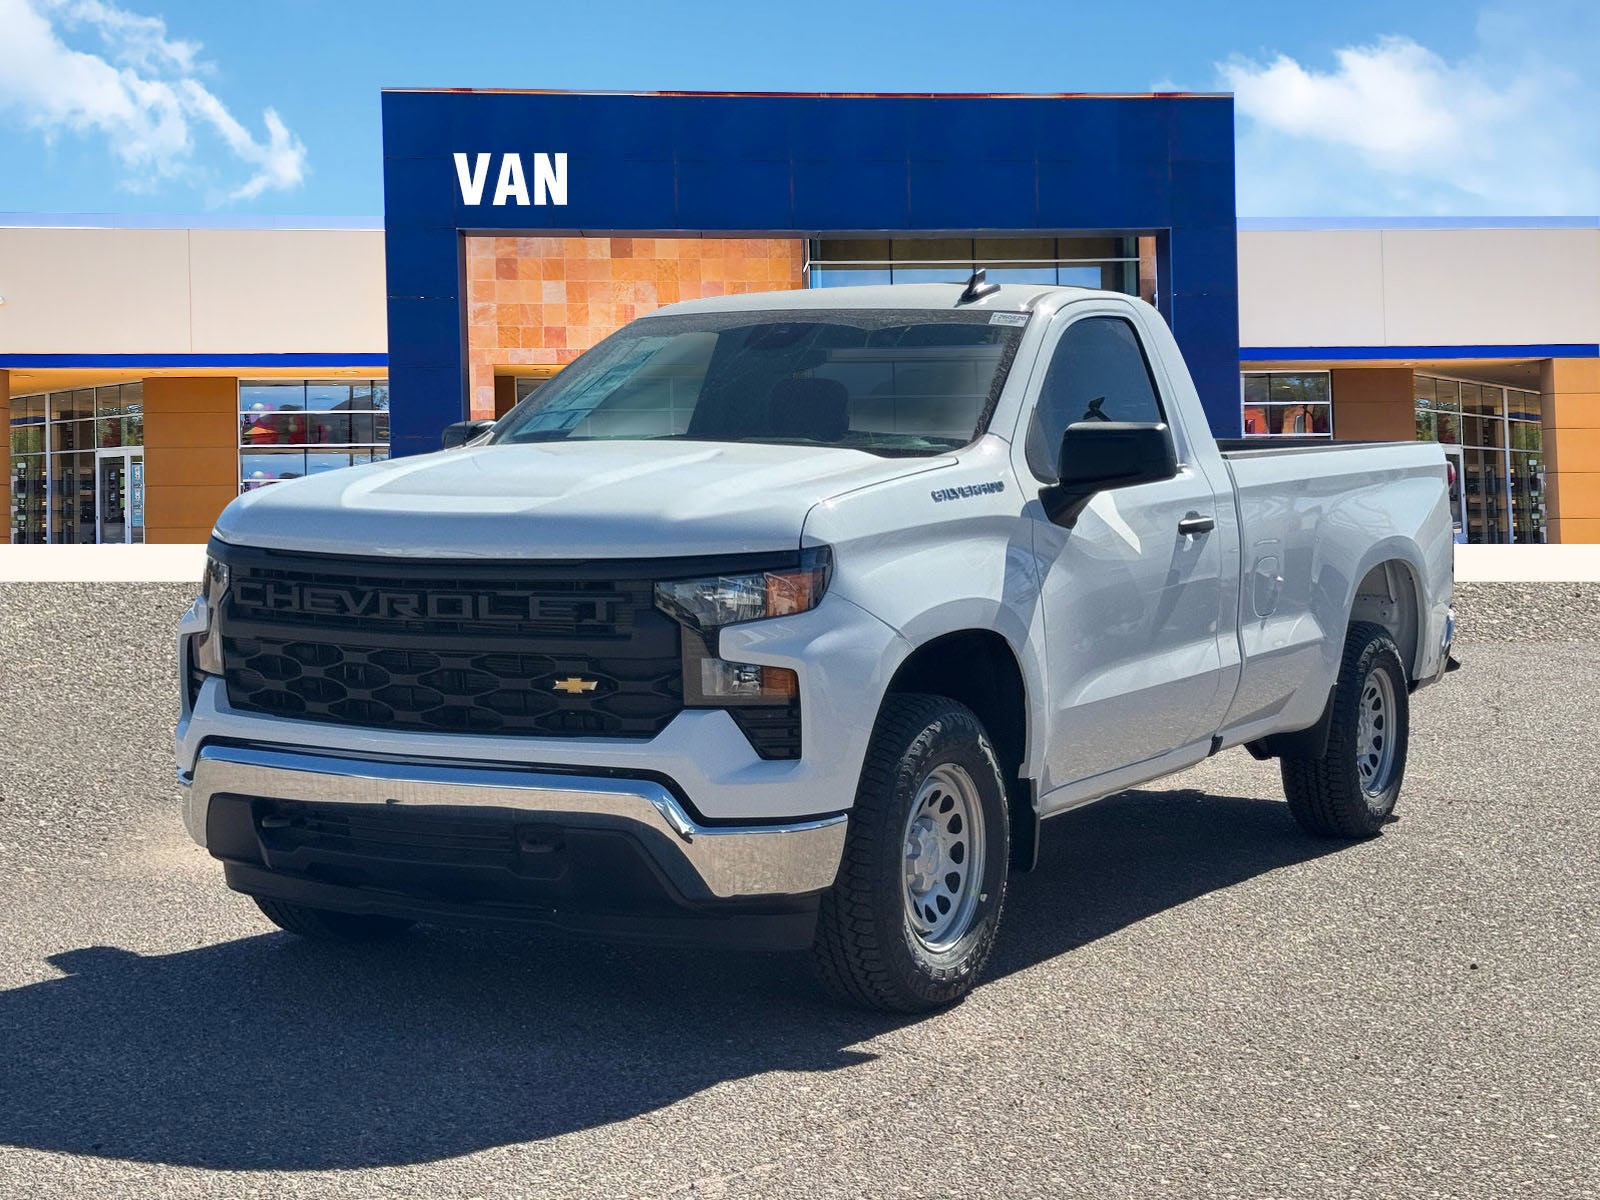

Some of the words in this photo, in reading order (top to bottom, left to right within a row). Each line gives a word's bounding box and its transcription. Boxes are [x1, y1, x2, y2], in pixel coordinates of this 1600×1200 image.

[453, 152, 568, 206] VAN
[931, 481, 1004, 502] SILVERADO
[234, 581, 629, 622] CHEVROLET
